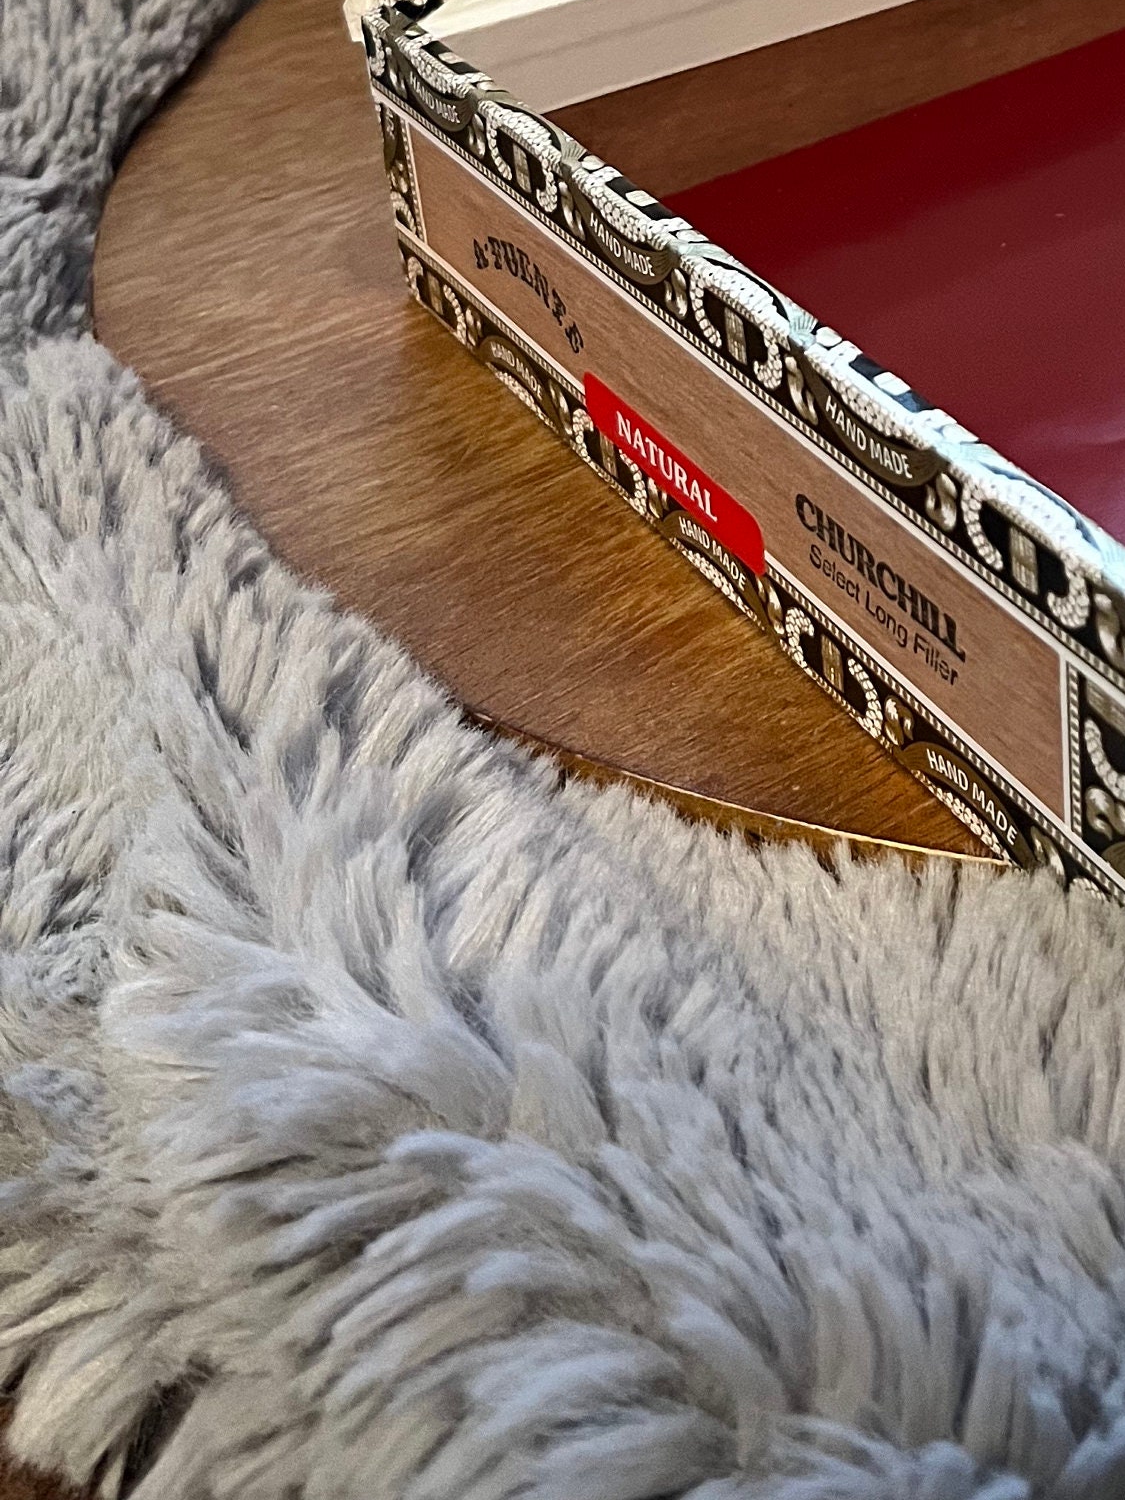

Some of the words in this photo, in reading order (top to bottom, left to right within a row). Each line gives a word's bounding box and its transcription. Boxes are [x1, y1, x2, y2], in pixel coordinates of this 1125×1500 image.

[409, 70, 435, 110] HAND
[435, 98, 461, 125] MADE
[589, 211, 622, 258] HAND
[622, 245, 656, 277] MADE
[515, 357, 543, 401] MADE
[615, 409, 718, 523] NATURAL
[824, 394, 868, 452] HAND
[869, 436, 914, 480] MADE
[678, 515, 711, 549] HAND
[711, 539, 748, 592] MADE
[794, 492, 967, 664] CHURCHILL
[808, 542, 861, 605] Select
[864, 589, 909, 649] Long
[912, 630, 959, 687] Filler
[926, 747, 969, 792] HAND
[971, 781, 1018, 847] MADE
